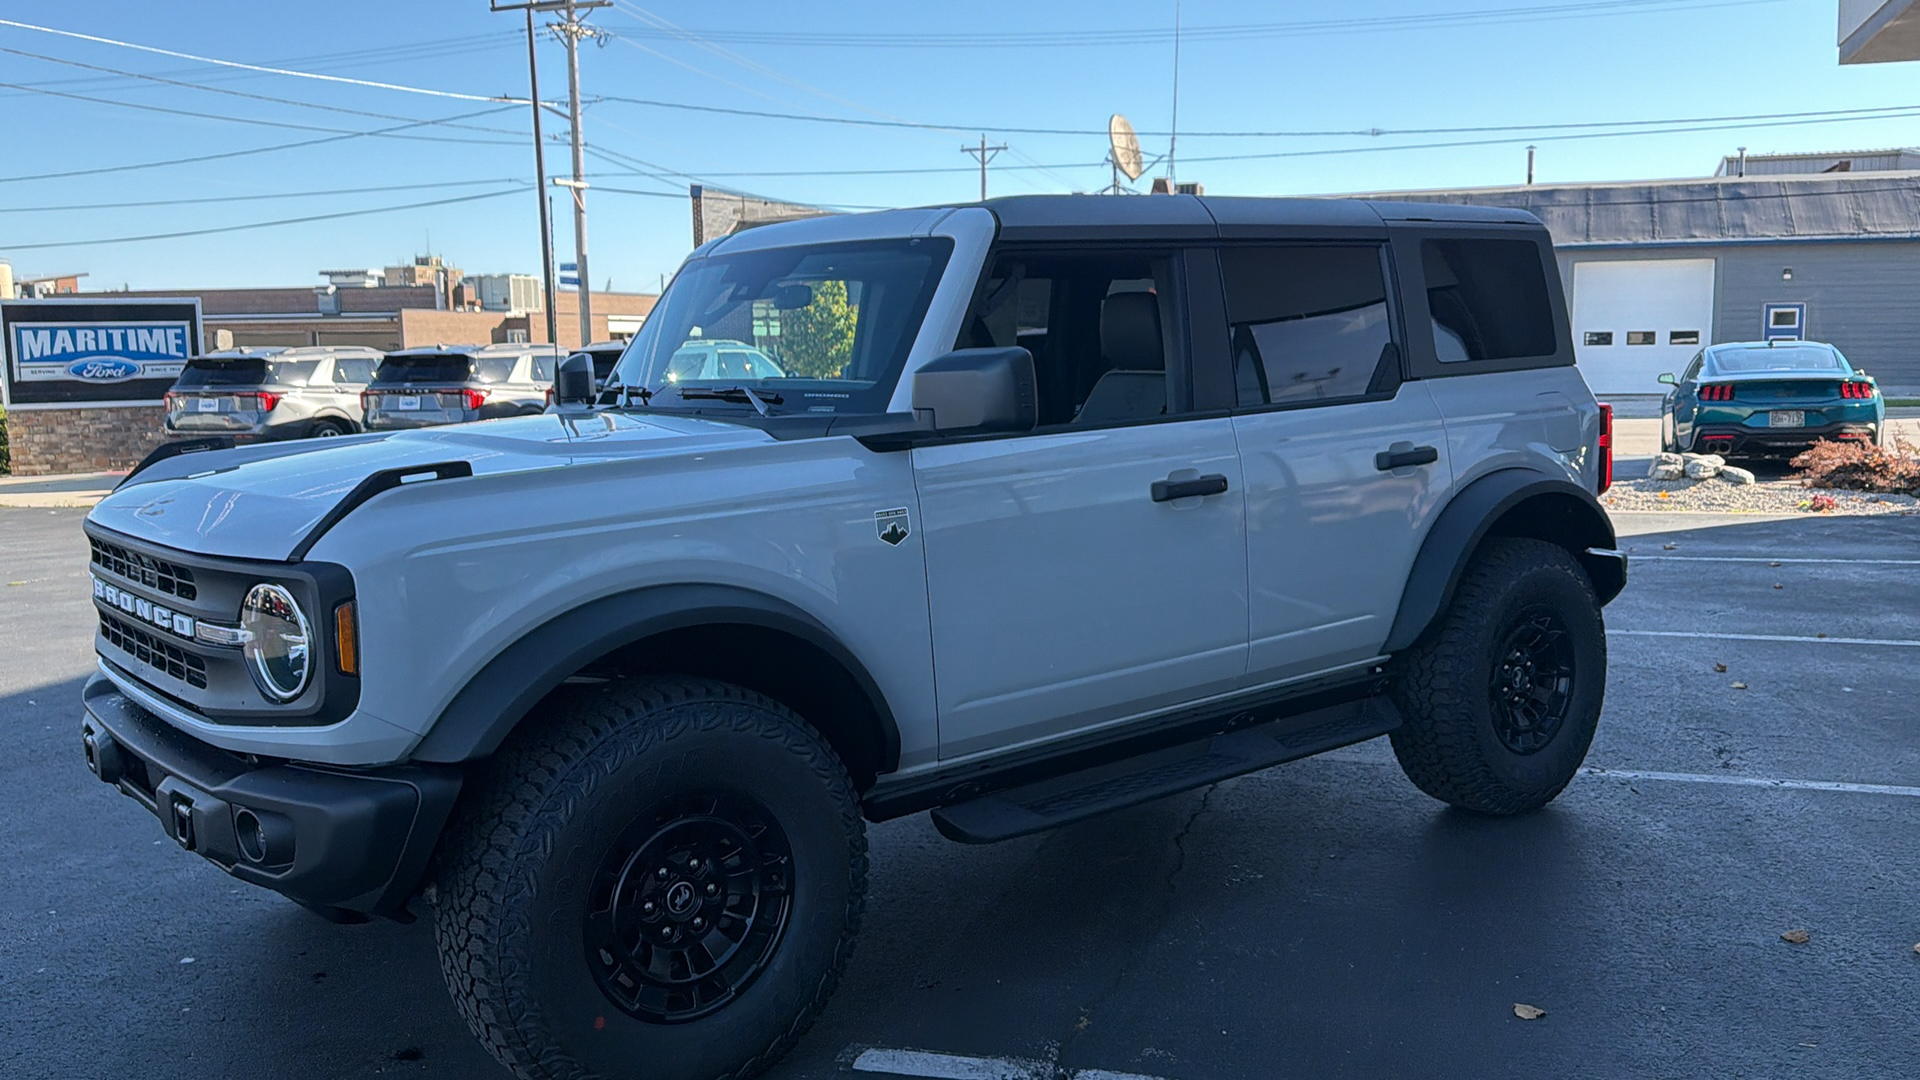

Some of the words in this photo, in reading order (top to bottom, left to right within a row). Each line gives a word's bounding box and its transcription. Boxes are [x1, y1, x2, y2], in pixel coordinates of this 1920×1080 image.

[21, 328, 184, 360] MARITIME
[82, 361, 126, 378] Ford
[93, 577, 194, 637] BRONCO
